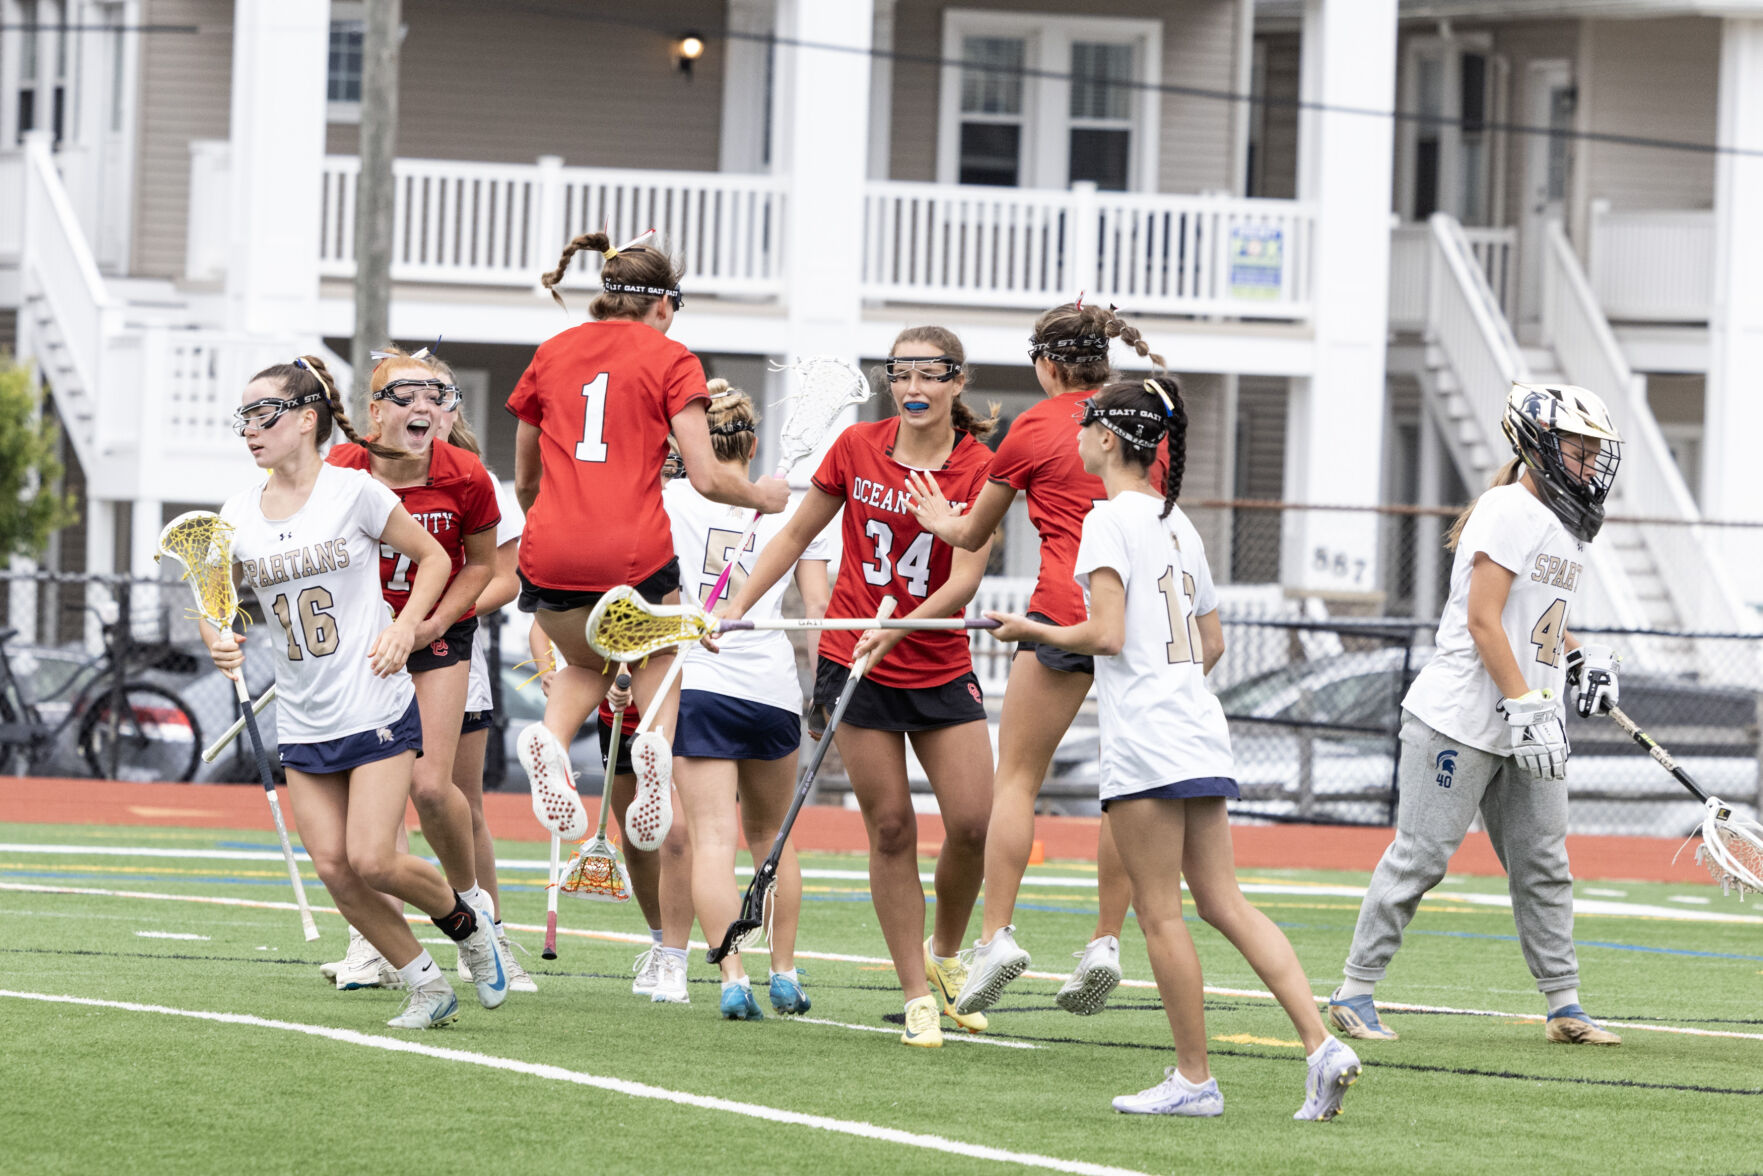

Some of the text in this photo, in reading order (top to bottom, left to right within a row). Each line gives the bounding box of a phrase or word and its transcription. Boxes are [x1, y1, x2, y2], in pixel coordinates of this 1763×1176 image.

[624, 284, 646, 293] GAIT
[647, 287, 665, 295] GAIT
[283, 392, 321, 408] TX STX
[574, 371, 610, 464] 1
[1108, 408, 1137, 417] GAIT
[1139, 410, 1163, 422] GAIT
[852, 476, 912, 516] OCEAN
[243, 537, 350, 590] PARTANS
[862, 518, 935, 598] 34
[271, 585, 341, 662] 16
[1436, 773, 1452, 788] 40
